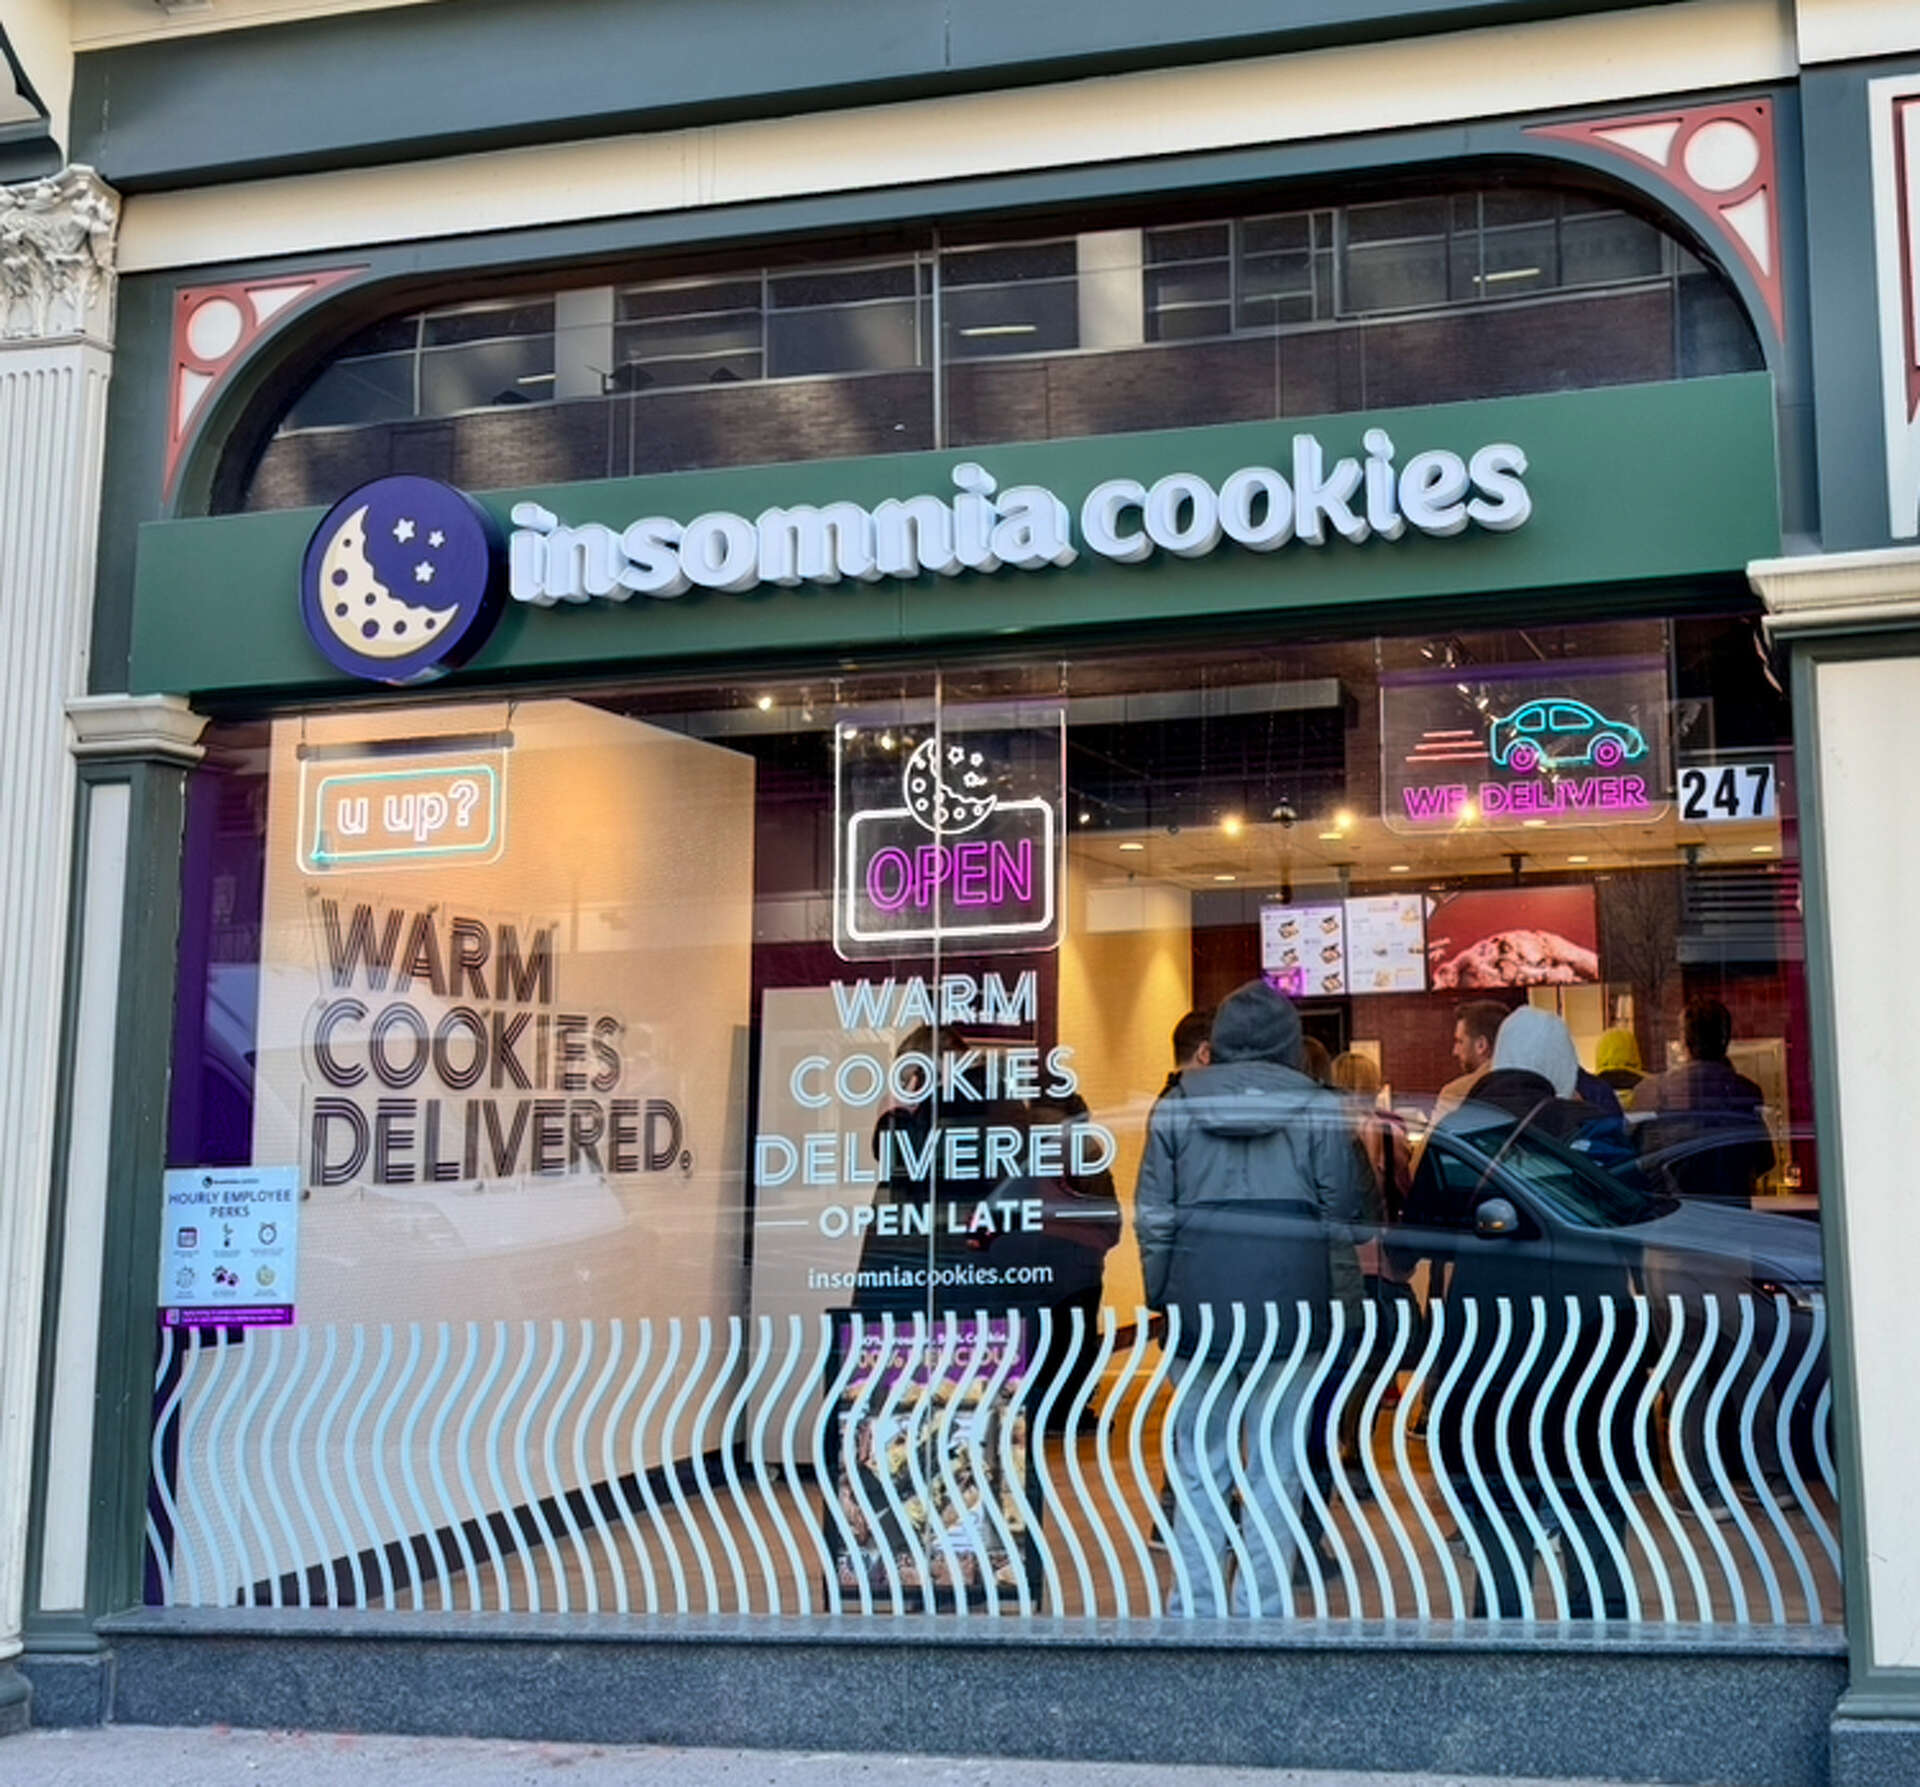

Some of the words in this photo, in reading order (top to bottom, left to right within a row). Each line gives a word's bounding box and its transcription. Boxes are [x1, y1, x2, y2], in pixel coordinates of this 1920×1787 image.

[509, 461, 1078, 607] insomnia
[1081, 428, 1532, 563] cookies
[337, 797, 367, 835] u
[385, 782, 479, 840] up?
[1480, 775, 1647, 815] DELIVER
[1682, 767, 1771, 819] 247
[867, 839, 1033, 911] OPEN
[320, 899, 554, 1003] WARM
[830, 970, 1037, 1031] WARM
[313, 998, 623, 1092] COOKIES
[790, 1046, 1079, 1108] COOKIES
[310, 1098, 693, 1187] DELIVERED.
[754, 1123, 1117, 1186] DELIVERED
[169, 1190, 220, 1205] HOURLY
[223, 1188, 292, 1203] EMPLOYEE
[209, 1205, 250, 1218] PERKS
[819, 1203, 931, 1238] OPEN
[946, 1199, 1044, 1235] LATE
[807, 1263, 1054, 1289] insomniacookies.com
